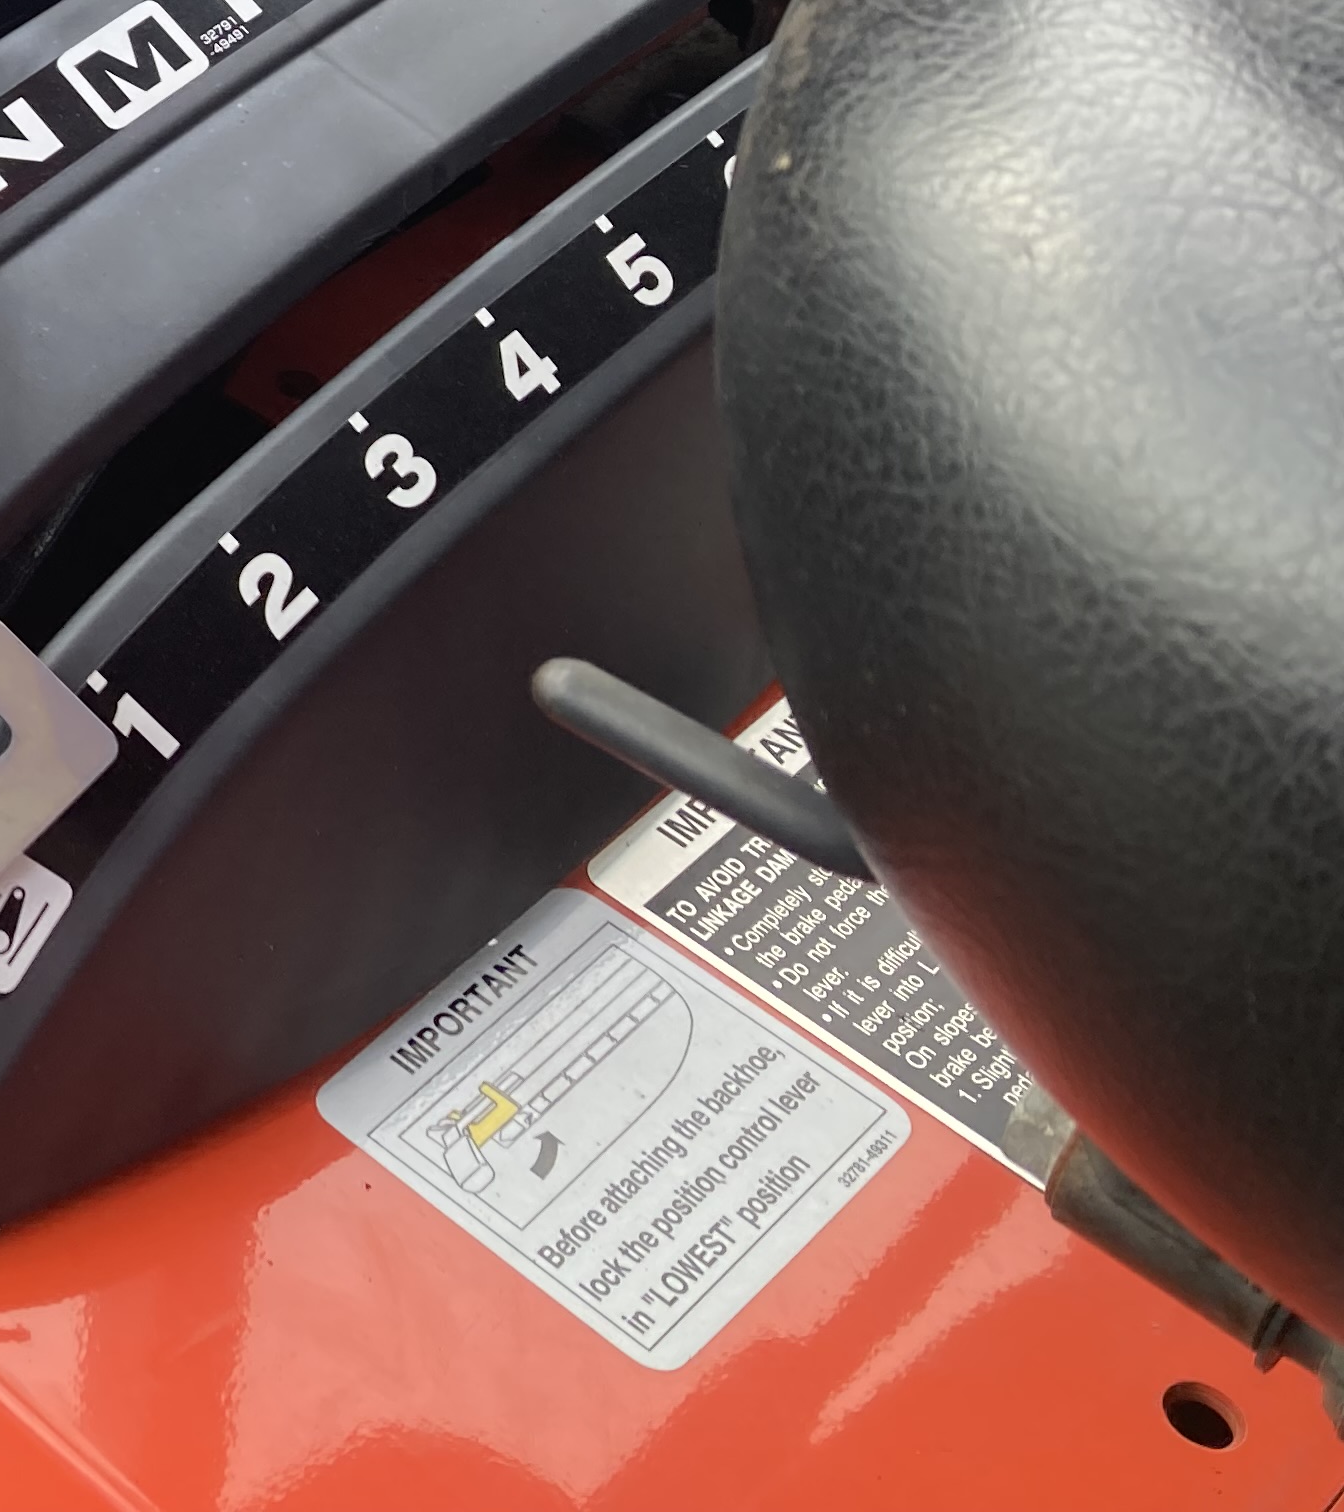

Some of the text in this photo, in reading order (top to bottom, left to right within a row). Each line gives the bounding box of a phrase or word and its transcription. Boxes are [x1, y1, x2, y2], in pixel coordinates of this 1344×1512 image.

[200, 16, 238, 45] 32791
[74, 16, 193, 113] M
[113, 233, 674, 761] 1 2 3 4 5
[665, 857, 746, 924] TO AVOID
[689, 878, 763, 942] LINKAGE
[731, 885, 813, 951] Completely
[754, 908, 827, 969] the brake
[778, 906, 872, 986] Do not force
[389, 943, 537, 1075] IMPORTANT
[802, 966, 850, 1002] lever.
[827, 975, 881, 1019] If it is
[852, 974, 925, 1036] lever into
[881, 997, 946, 1057] position;
[905, 1045, 937, 1069] On
[929, 1048, 978, 1089] brake
[536, 1046, 786, 1270] Before attaching the backhoe,
[578, 1071, 821, 1303] lock the position control lever
[837, 1129, 898, 1188] 32781-49311
[621, 1155, 811, 1335] in "LOWEST" position
